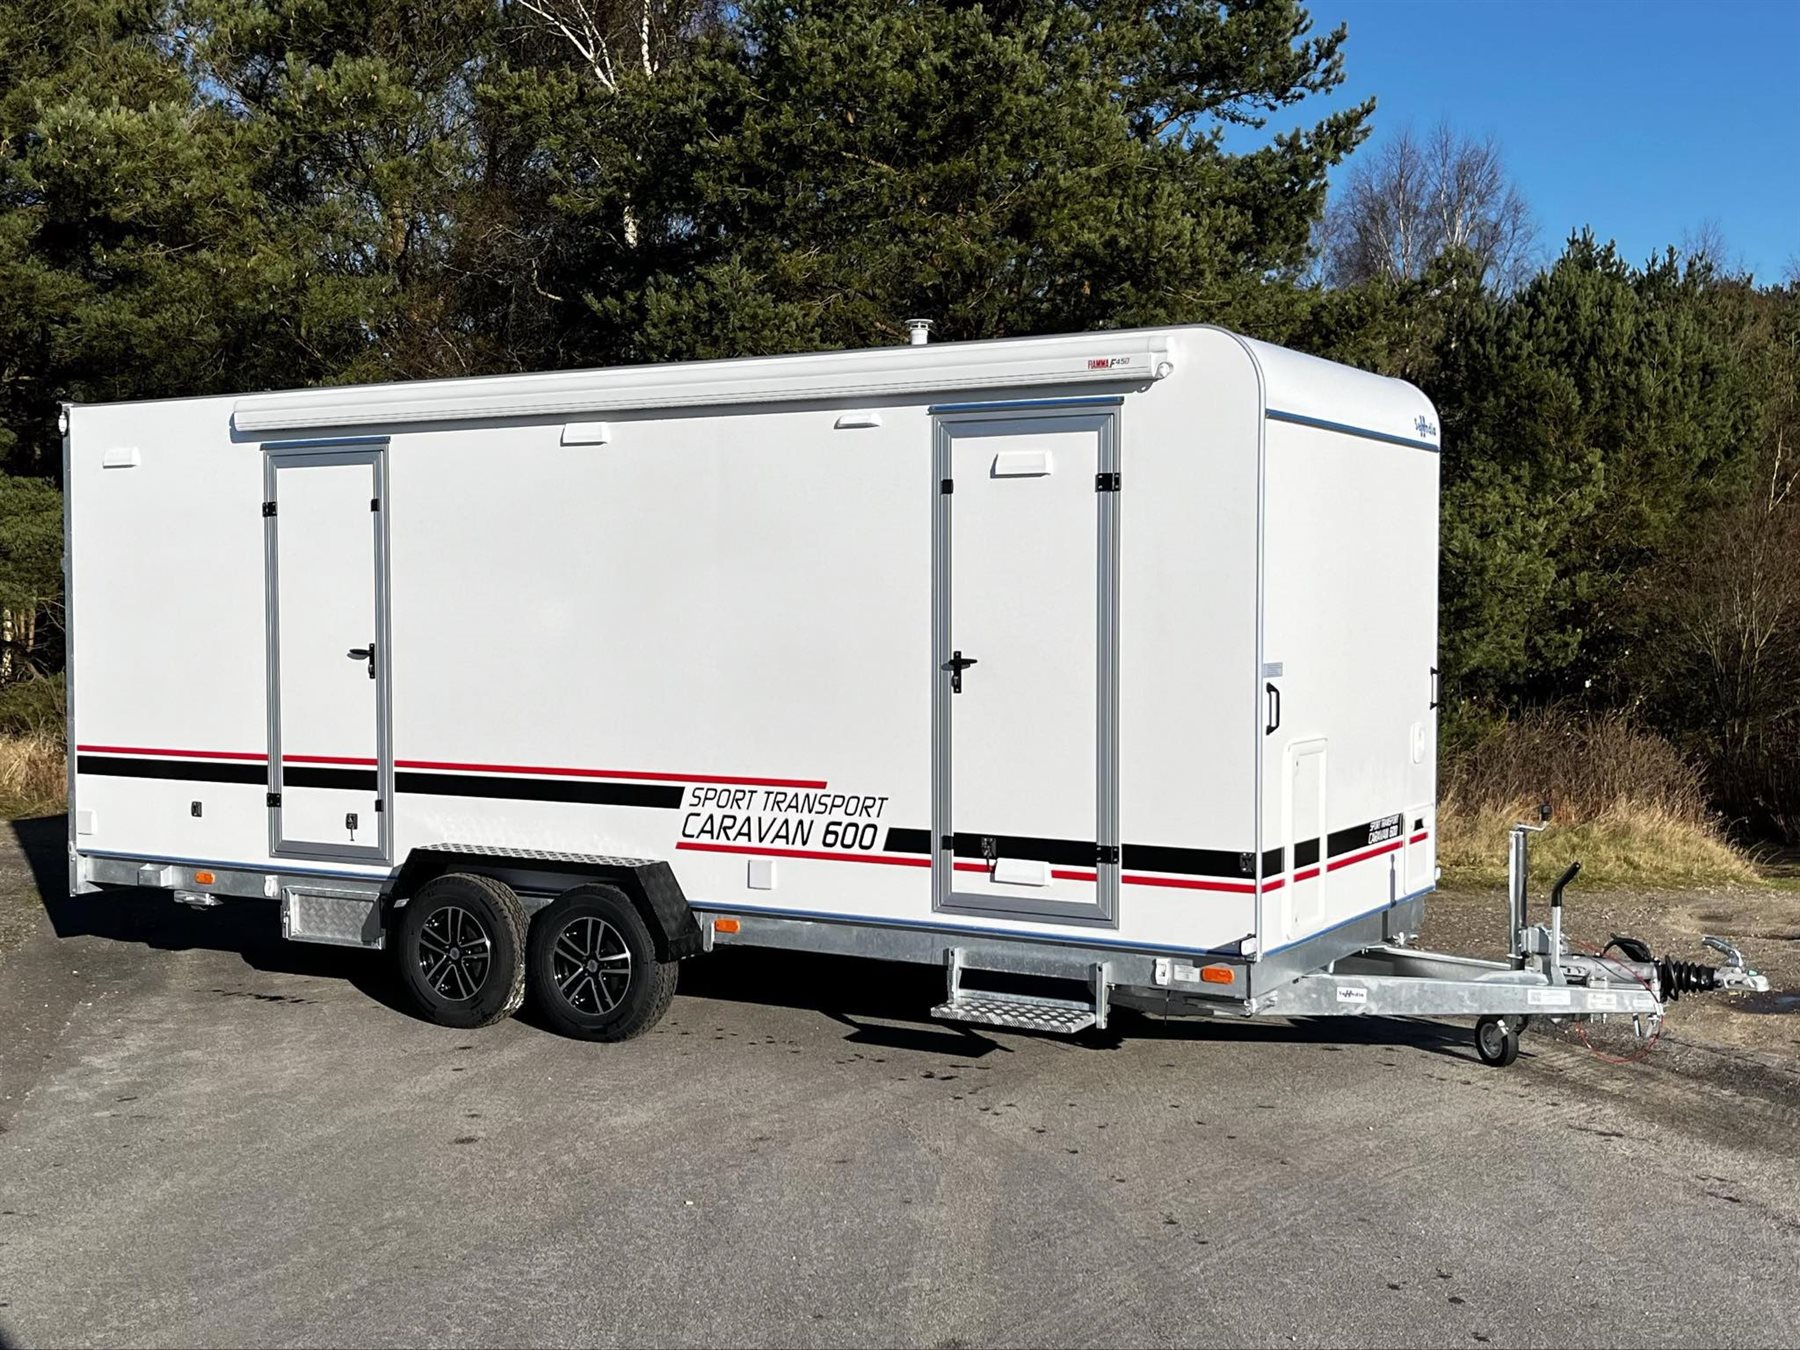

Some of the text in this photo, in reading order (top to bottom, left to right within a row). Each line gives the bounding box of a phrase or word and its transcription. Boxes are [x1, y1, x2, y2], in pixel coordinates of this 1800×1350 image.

[689, 787, 889, 818] SPORT TRANSPORT
[681, 812, 878, 850] CARAVAN 600
